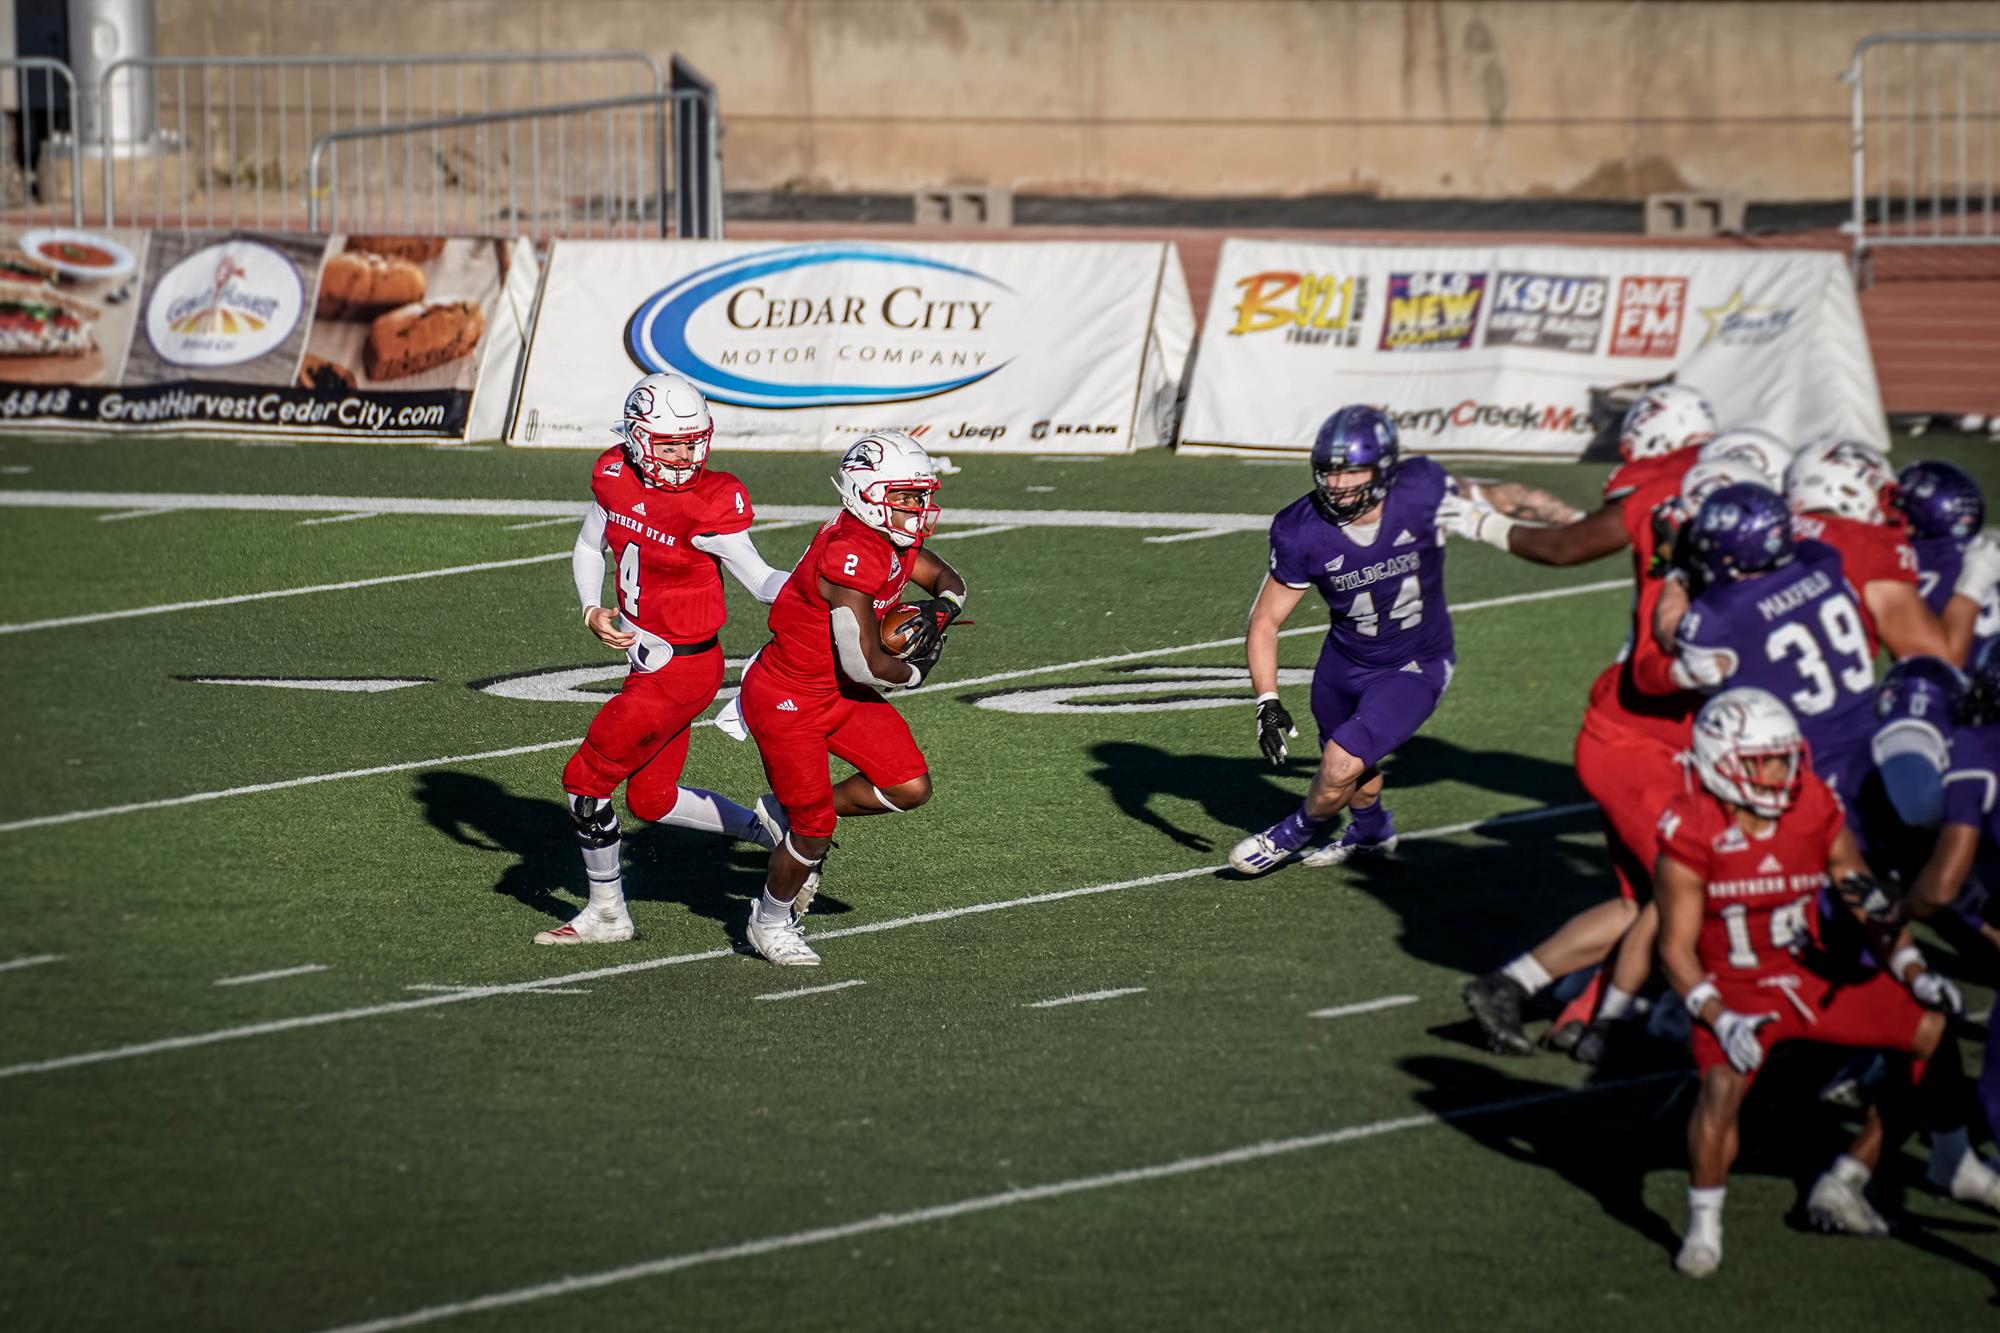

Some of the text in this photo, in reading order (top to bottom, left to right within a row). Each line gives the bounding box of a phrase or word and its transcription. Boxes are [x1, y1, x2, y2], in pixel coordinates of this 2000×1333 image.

[727, 286, 992, 331] CEDAR CITY
[1388, 288, 1482, 333] NEW
[1497, 276, 1605, 316] KSUB
[1624, 281, 1682, 309] DAVE
[1619, 307, 1678, 339] FM
[720, 344, 988, 367] MOTOR COMPANY
[99, 389, 446, 431] GreatHarvestCedarCity.com
[949, 422, 1007, 442] Jeep
[1056, 424, 1119, 434] RAM
[735, 492, 745, 515] 4
[645, 526, 676, 547] UTAH
[619, 540, 642, 619] 4
[843, 553, 859, 577] 2
[1330, 551, 1422, 592] WILDCATS
[1346, 574, 1424, 638] 44
[1765, 593, 1875, 715] 39
